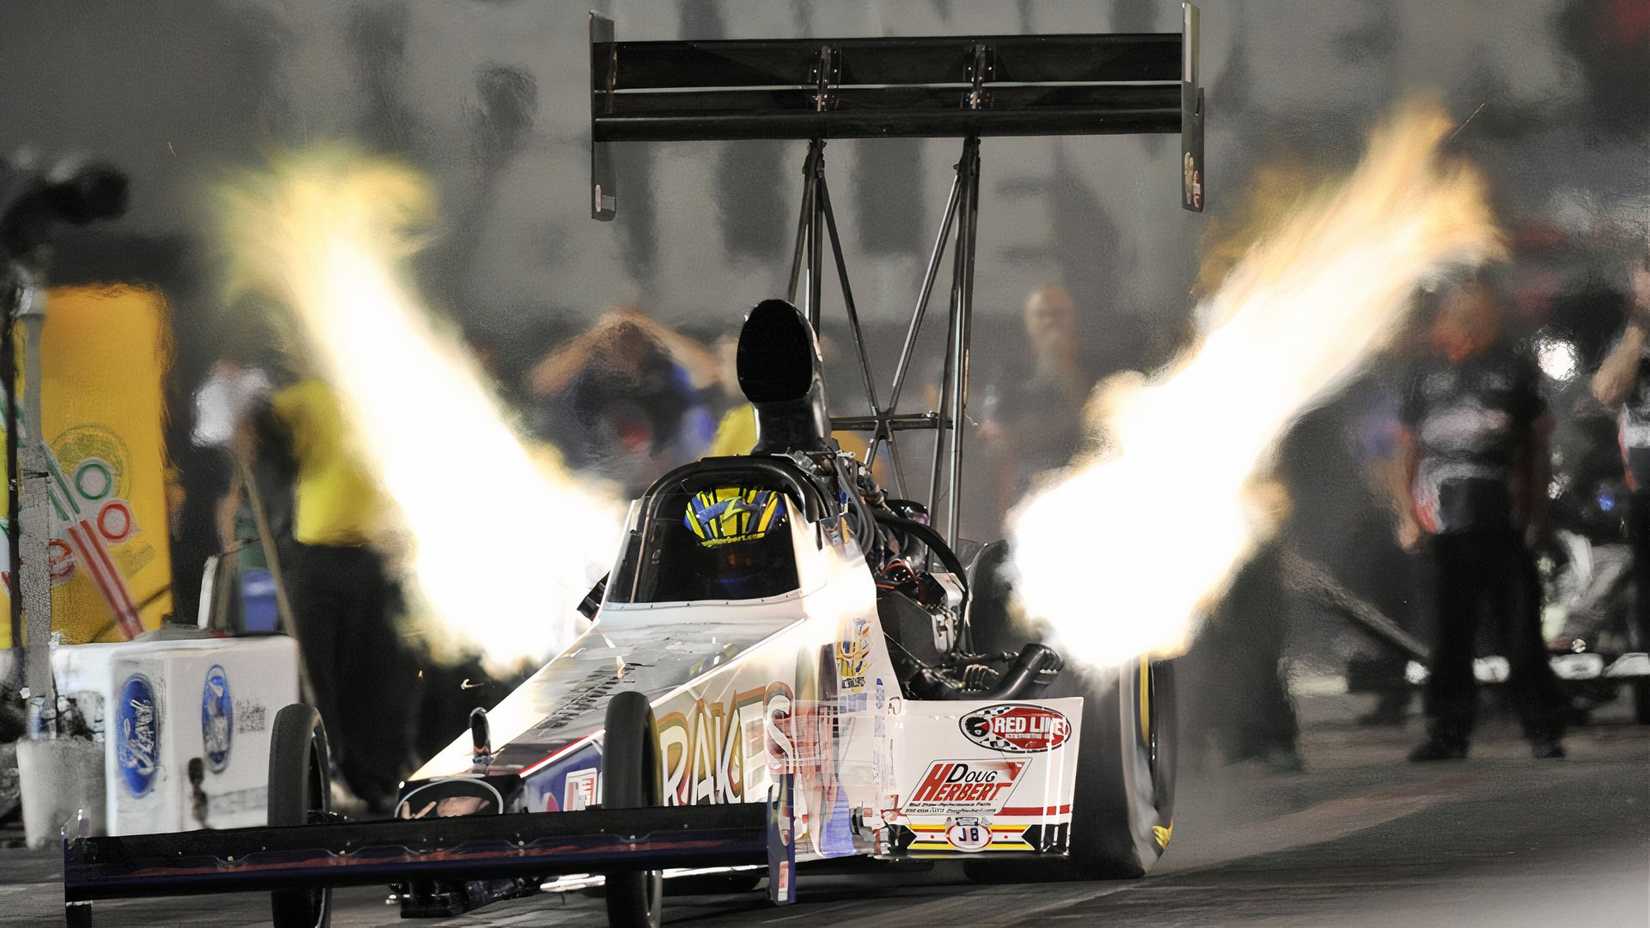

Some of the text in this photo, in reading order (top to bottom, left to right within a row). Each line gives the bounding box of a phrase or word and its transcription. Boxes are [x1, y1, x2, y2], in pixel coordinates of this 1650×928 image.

[993, 716, 1026, 733] RED
[912, 763, 1013, 801] HERBERT
[946, 763, 998, 783] DOUG
